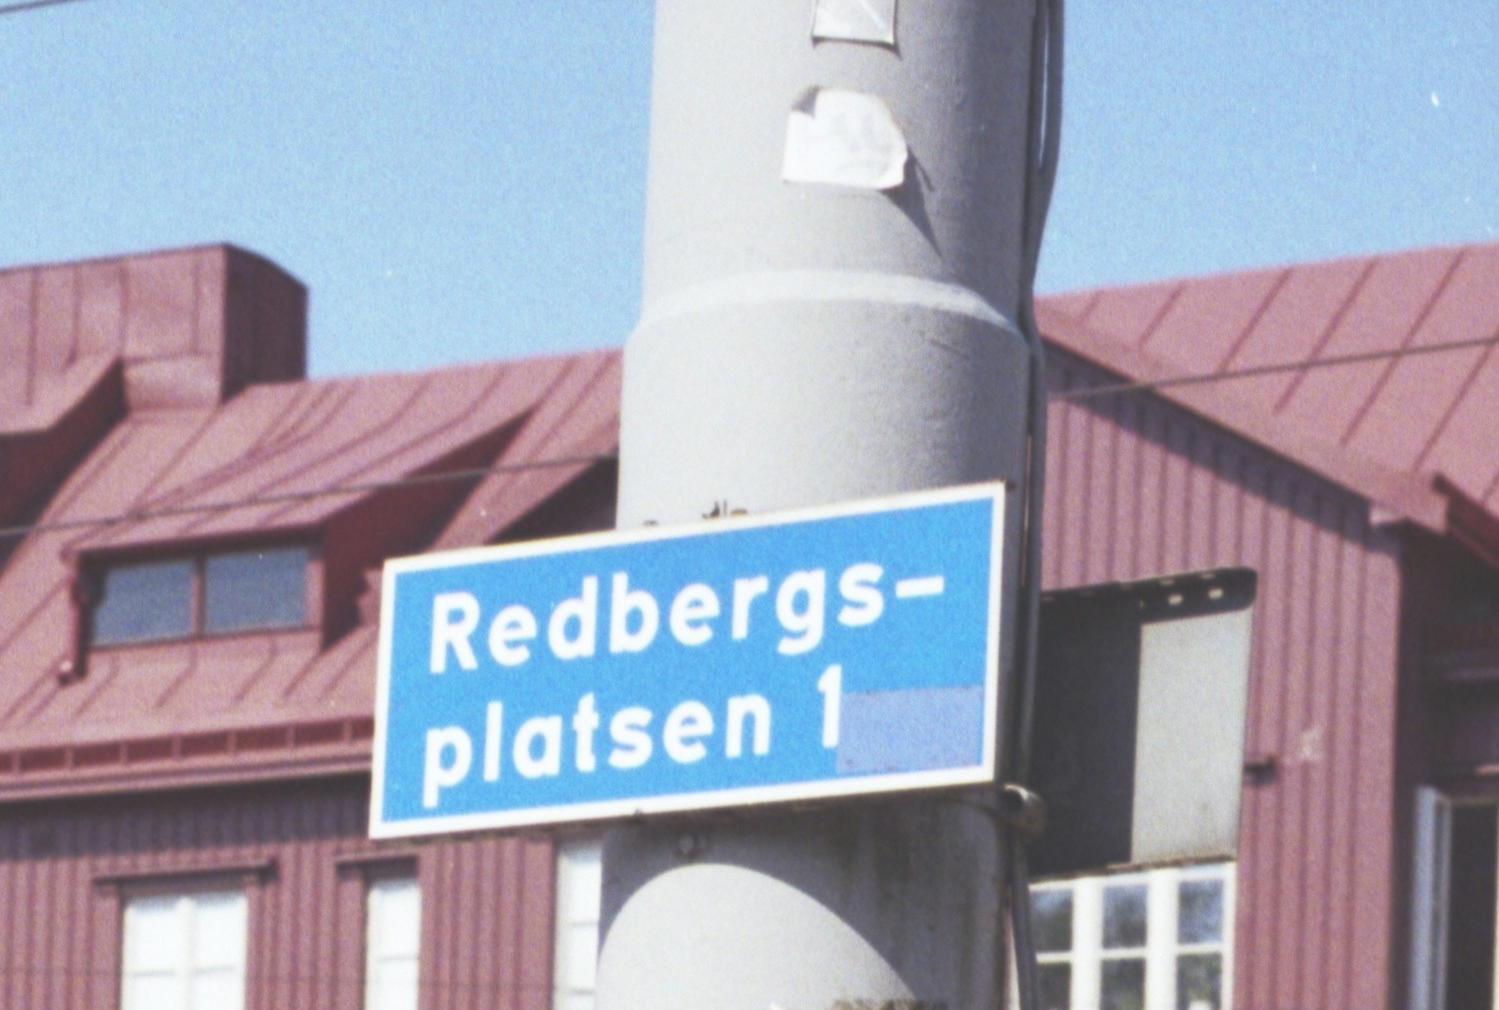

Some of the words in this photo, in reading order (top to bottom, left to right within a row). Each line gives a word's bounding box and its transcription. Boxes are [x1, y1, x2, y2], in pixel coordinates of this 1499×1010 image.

[430, 561, 945, 673] Redbergs-
[422, 691, 771, 808] platsen
[817, 663, 843, 748] 1
